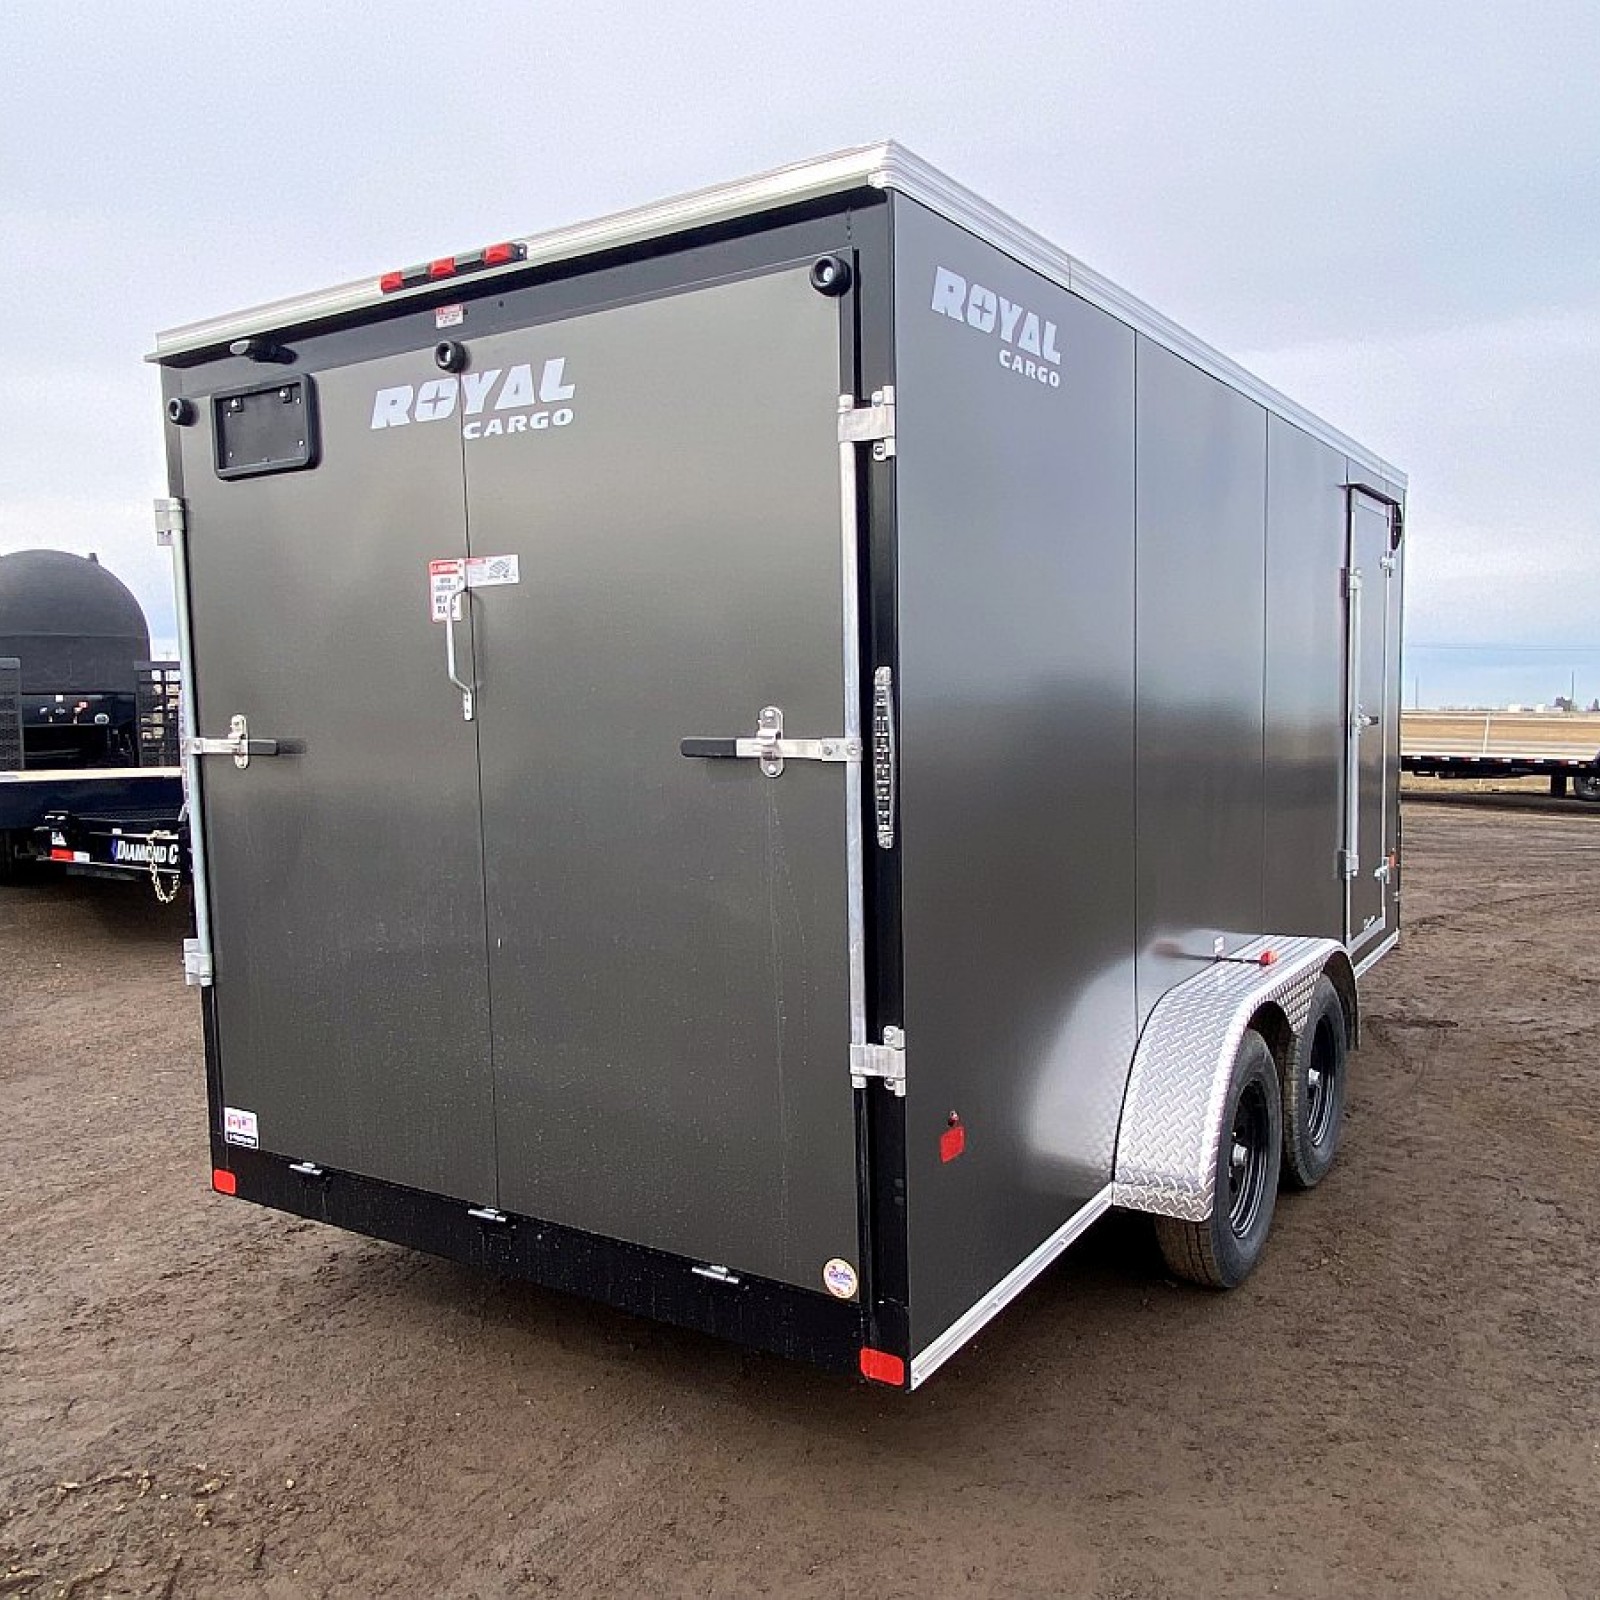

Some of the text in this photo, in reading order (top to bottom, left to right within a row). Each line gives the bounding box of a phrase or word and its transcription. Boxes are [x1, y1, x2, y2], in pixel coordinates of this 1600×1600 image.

[931, 265, 1061, 366] ROYAL
[999, 349, 1060, 388] CARGO
[370, 356, 576, 430] ROYAL
[463, 408, 574, 440] CARGO
[168, 844, 179, 865] C
